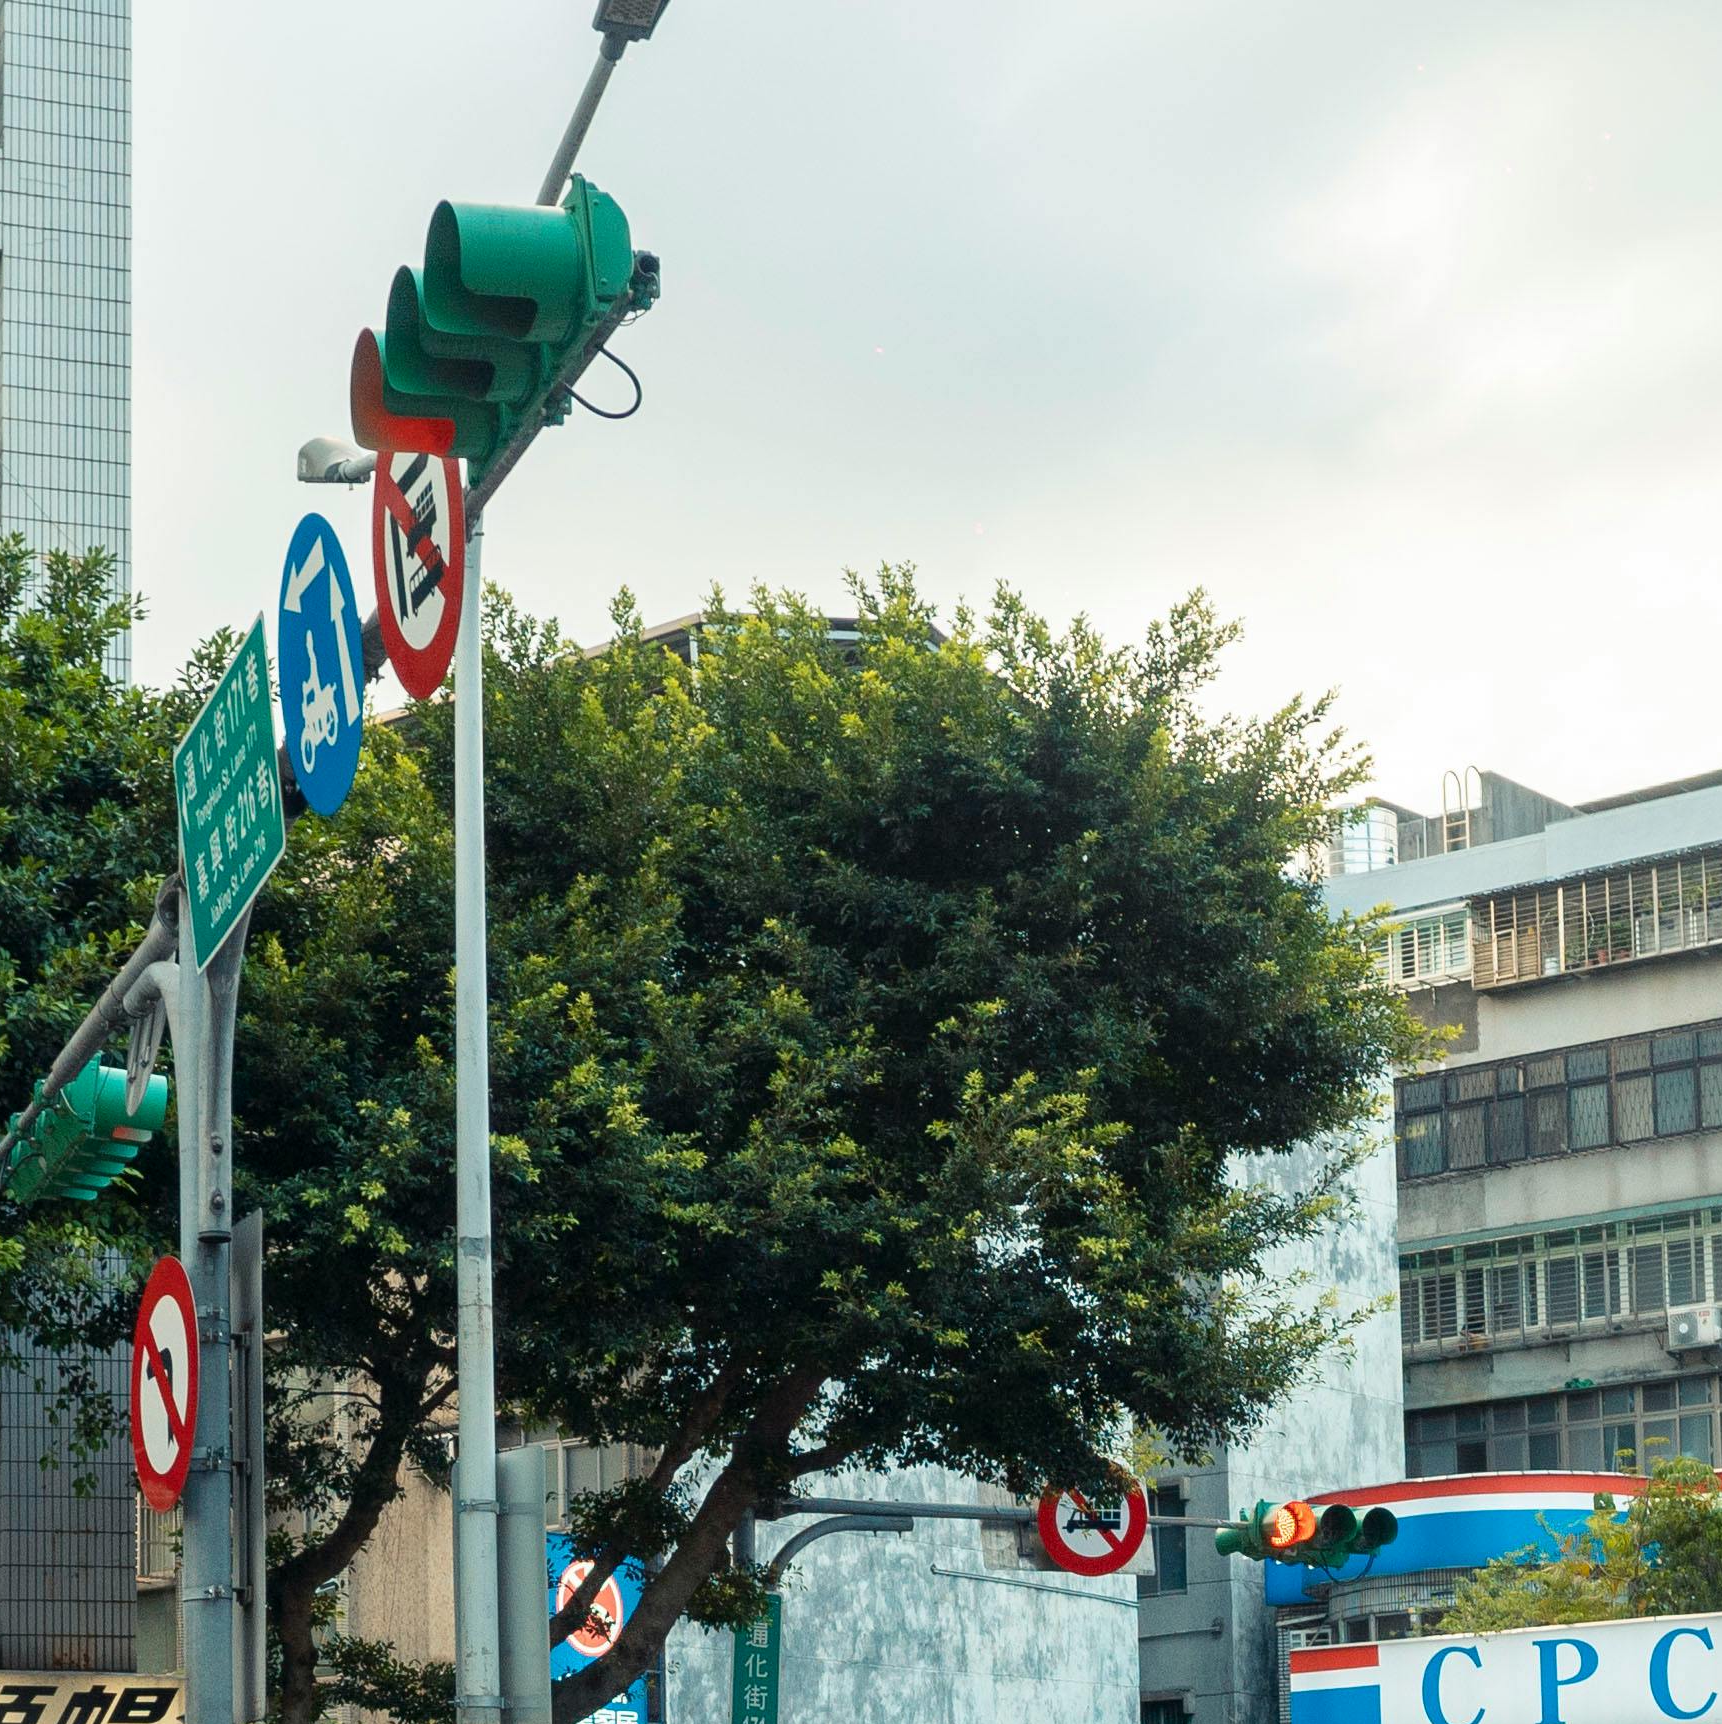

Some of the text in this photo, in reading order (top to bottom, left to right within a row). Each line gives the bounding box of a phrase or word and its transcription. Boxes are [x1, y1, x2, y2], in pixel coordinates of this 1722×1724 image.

[184, 650, 259, 801] 通化街171巷
[245, 721, 258, 752] 171
[195, 756, 270, 904] 嘉興街216巷
